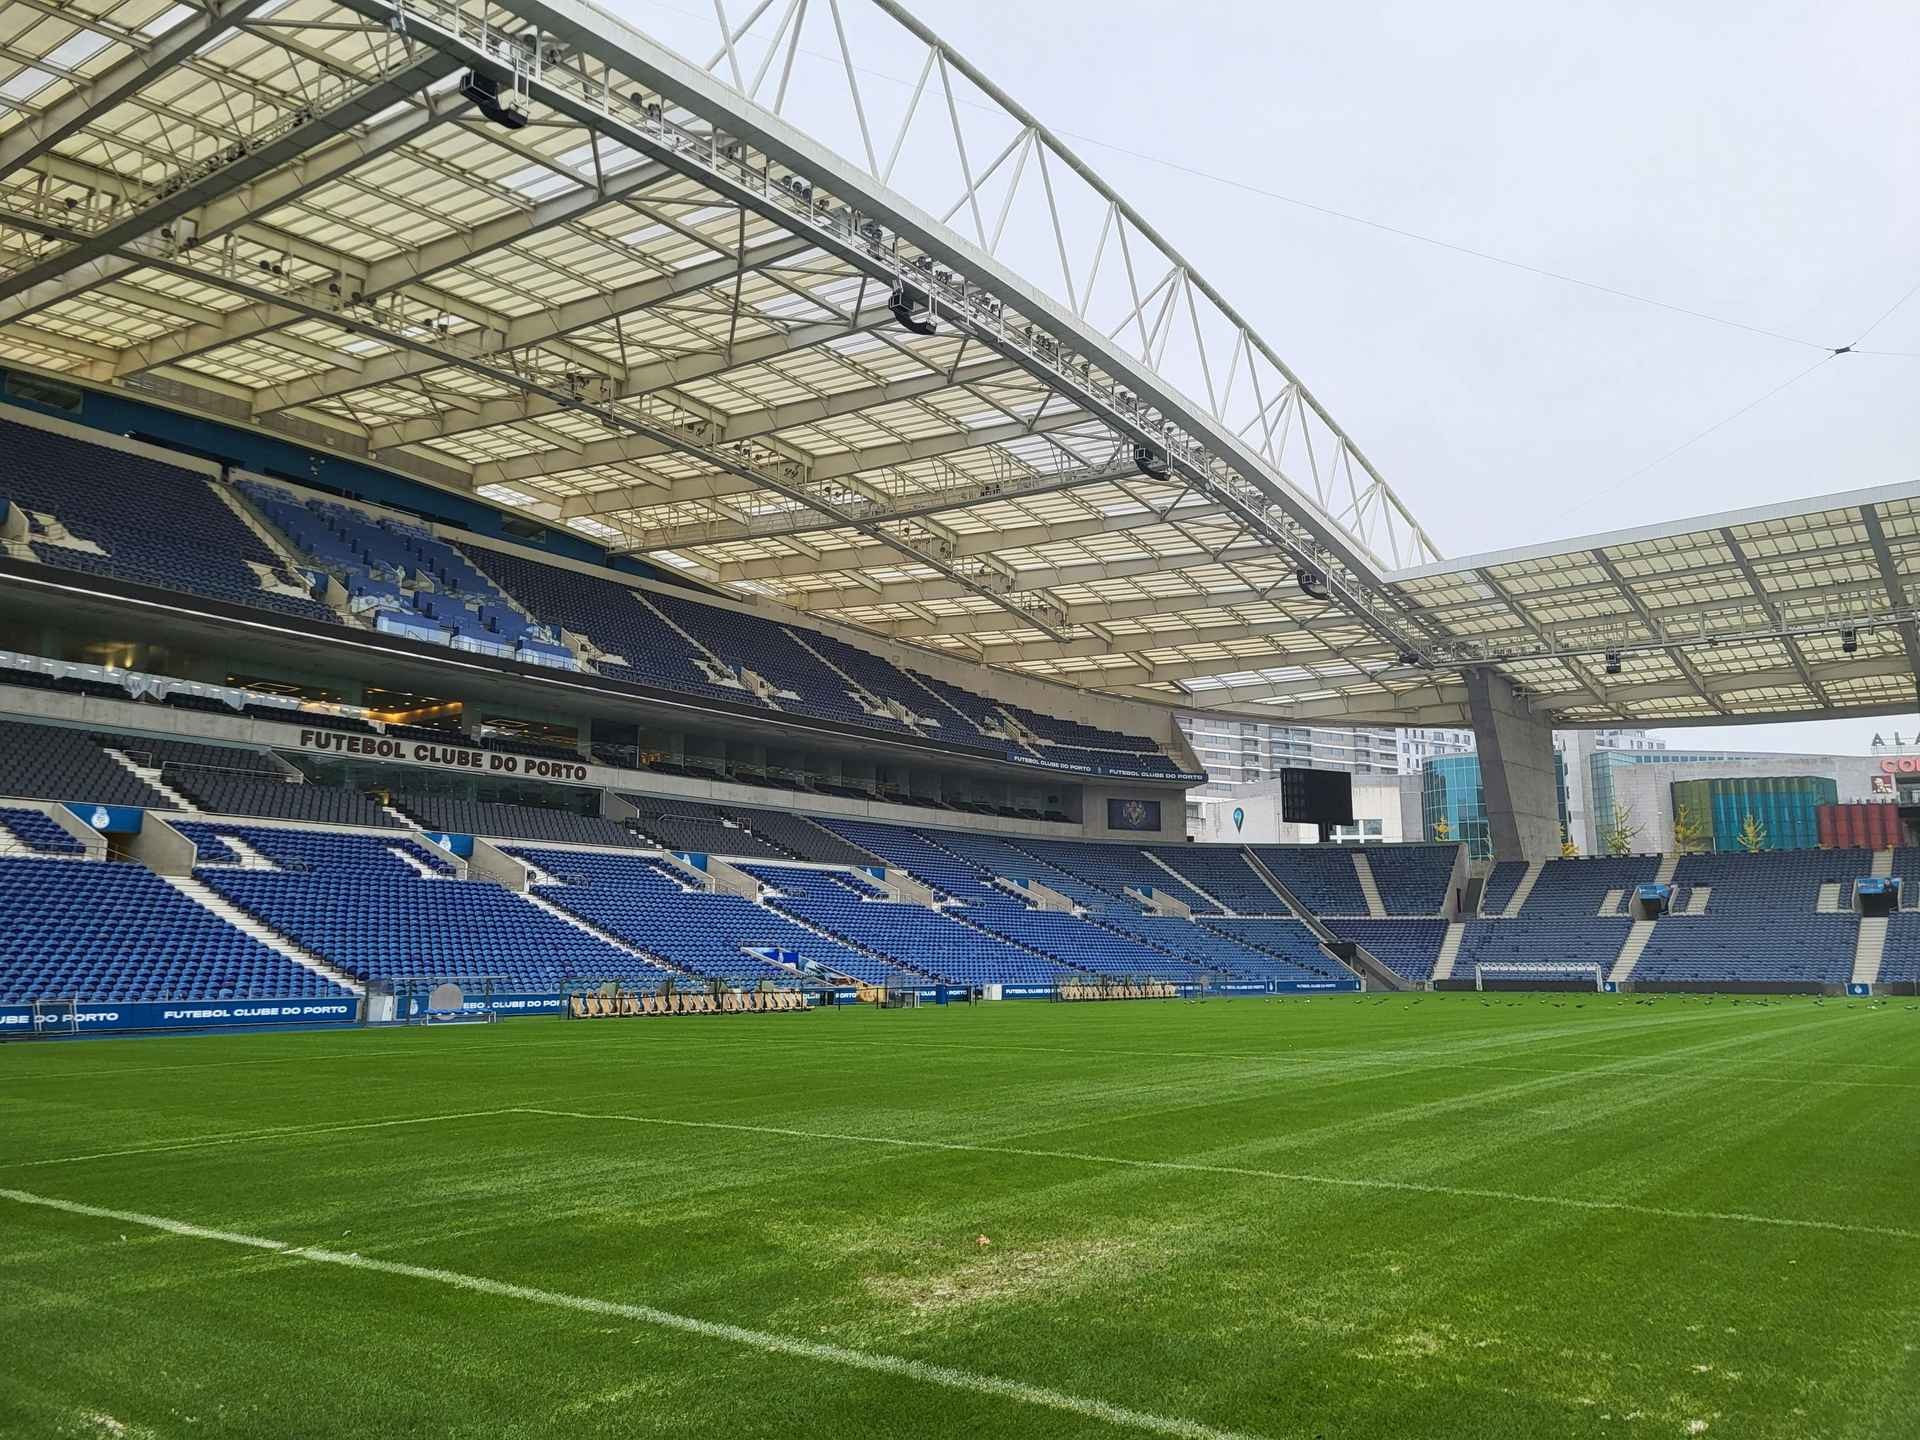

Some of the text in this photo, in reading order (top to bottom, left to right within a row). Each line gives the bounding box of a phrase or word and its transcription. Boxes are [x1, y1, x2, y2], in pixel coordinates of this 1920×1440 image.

[300, 730, 587, 781] FUTEBOL CLUBE DO PORTO
[1881, 759, 1920, 774] CO
[492, 1001, 526, 1009] CLUBE
[527, 1000, 541, 1008] DO
[62, 1012, 119, 1023] PORTO
[164, 1005, 347, 1019] FUTEBOL CLUBE DO PORTO
